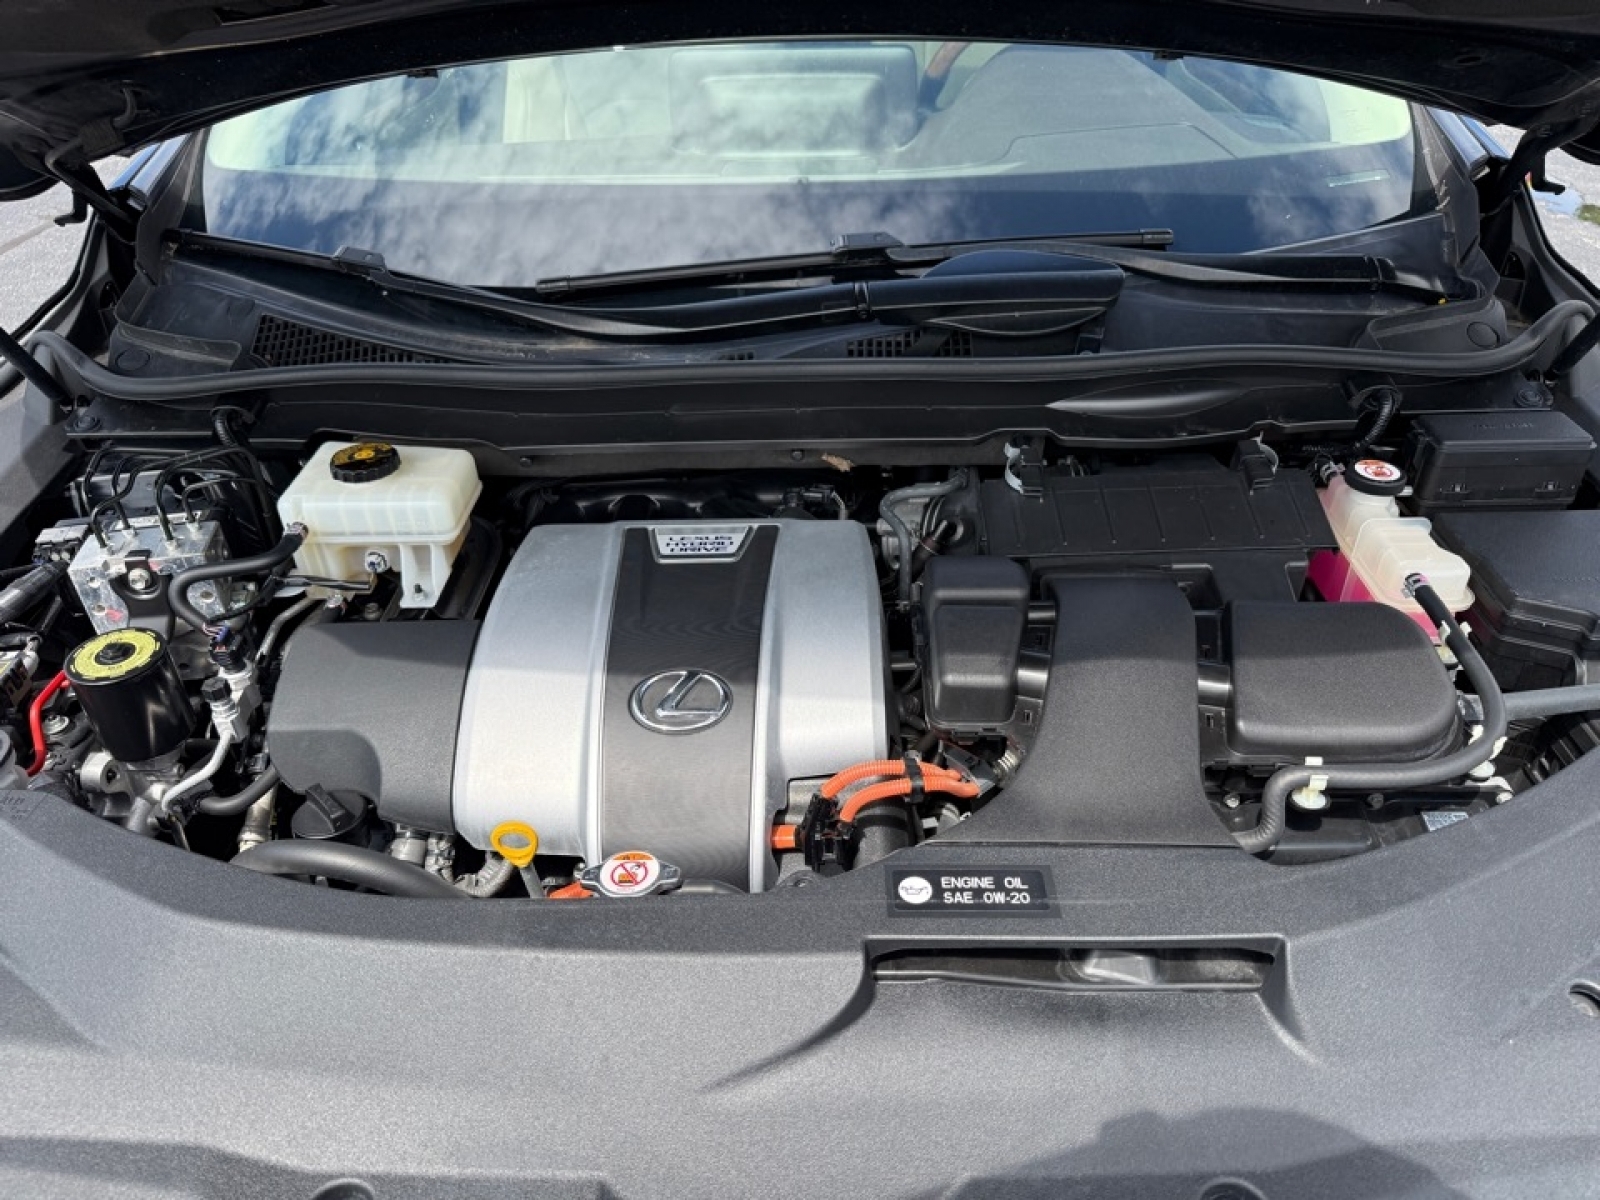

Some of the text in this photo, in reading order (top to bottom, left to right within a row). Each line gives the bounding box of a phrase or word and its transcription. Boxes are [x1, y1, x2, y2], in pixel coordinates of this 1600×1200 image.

[941, 876, 1030, 889] ENGINE OIL
[943, 891, 1031, 904] SAE 0W-20
